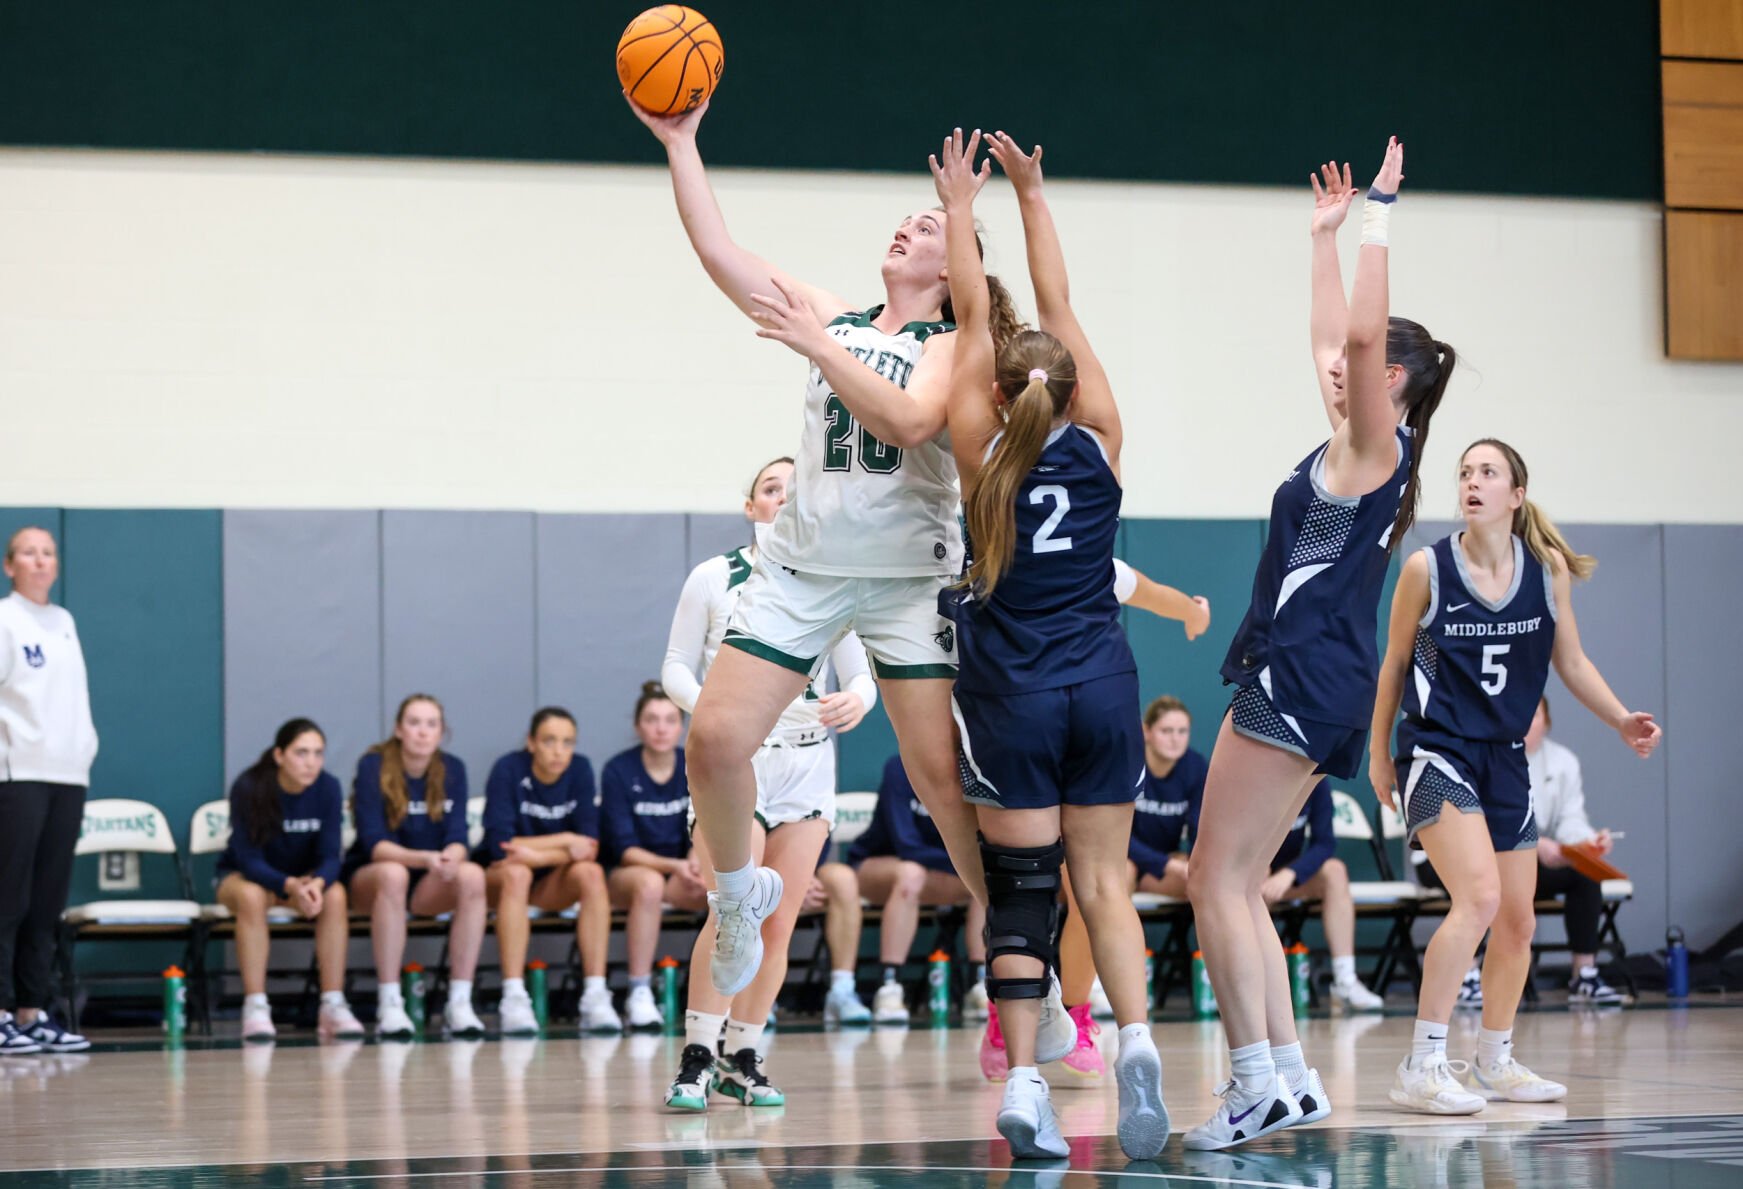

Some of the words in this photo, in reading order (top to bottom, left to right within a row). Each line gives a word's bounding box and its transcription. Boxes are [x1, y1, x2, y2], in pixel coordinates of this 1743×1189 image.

[817, 346, 914, 391] TLETO
[1028, 484, 1073, 554] 2
[1444, 616, 1542, 637] MIDDLEBURY
[1480, 643, 1511, 696] 5
[80, 813, 156, 837] PARTANS
